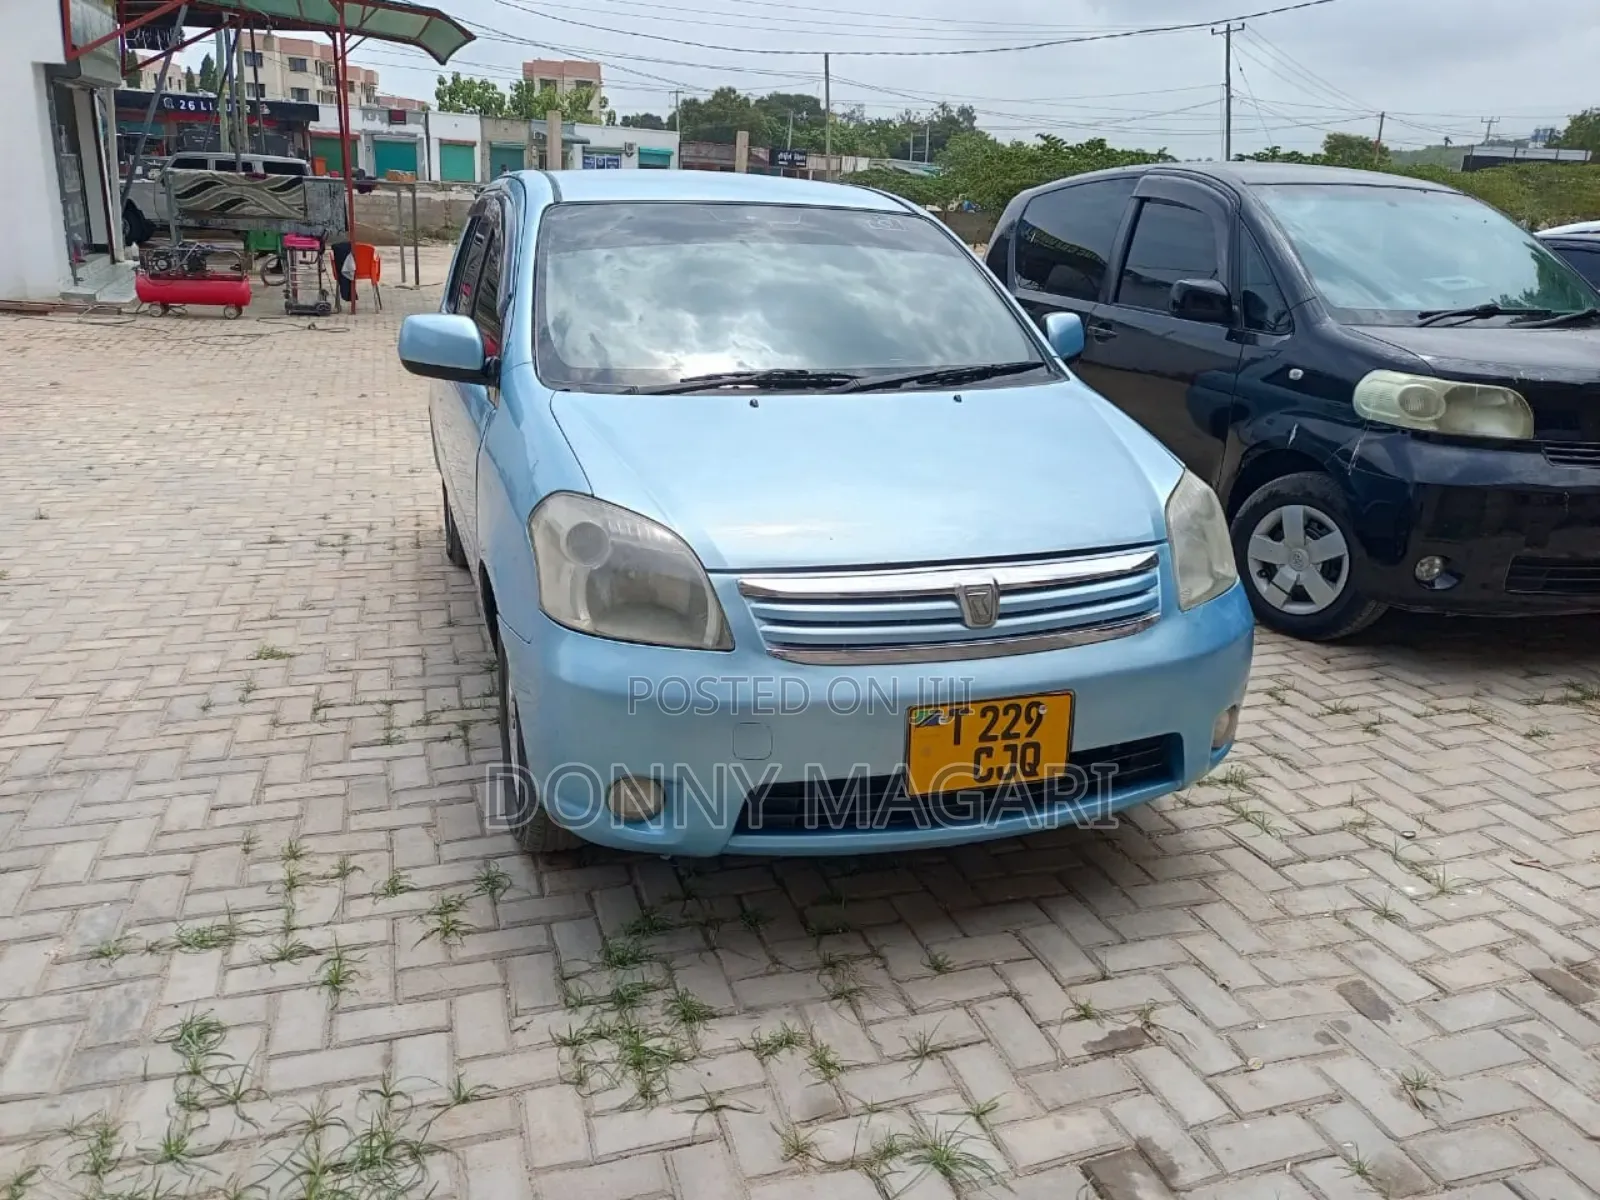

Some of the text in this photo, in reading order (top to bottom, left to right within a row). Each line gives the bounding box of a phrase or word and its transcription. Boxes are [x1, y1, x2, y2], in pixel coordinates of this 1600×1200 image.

[179, 99, 251, 114] 26 LIUR
[948, 700, 1046, 746] T 229
[972, 741, 1042, 784] CJQ
